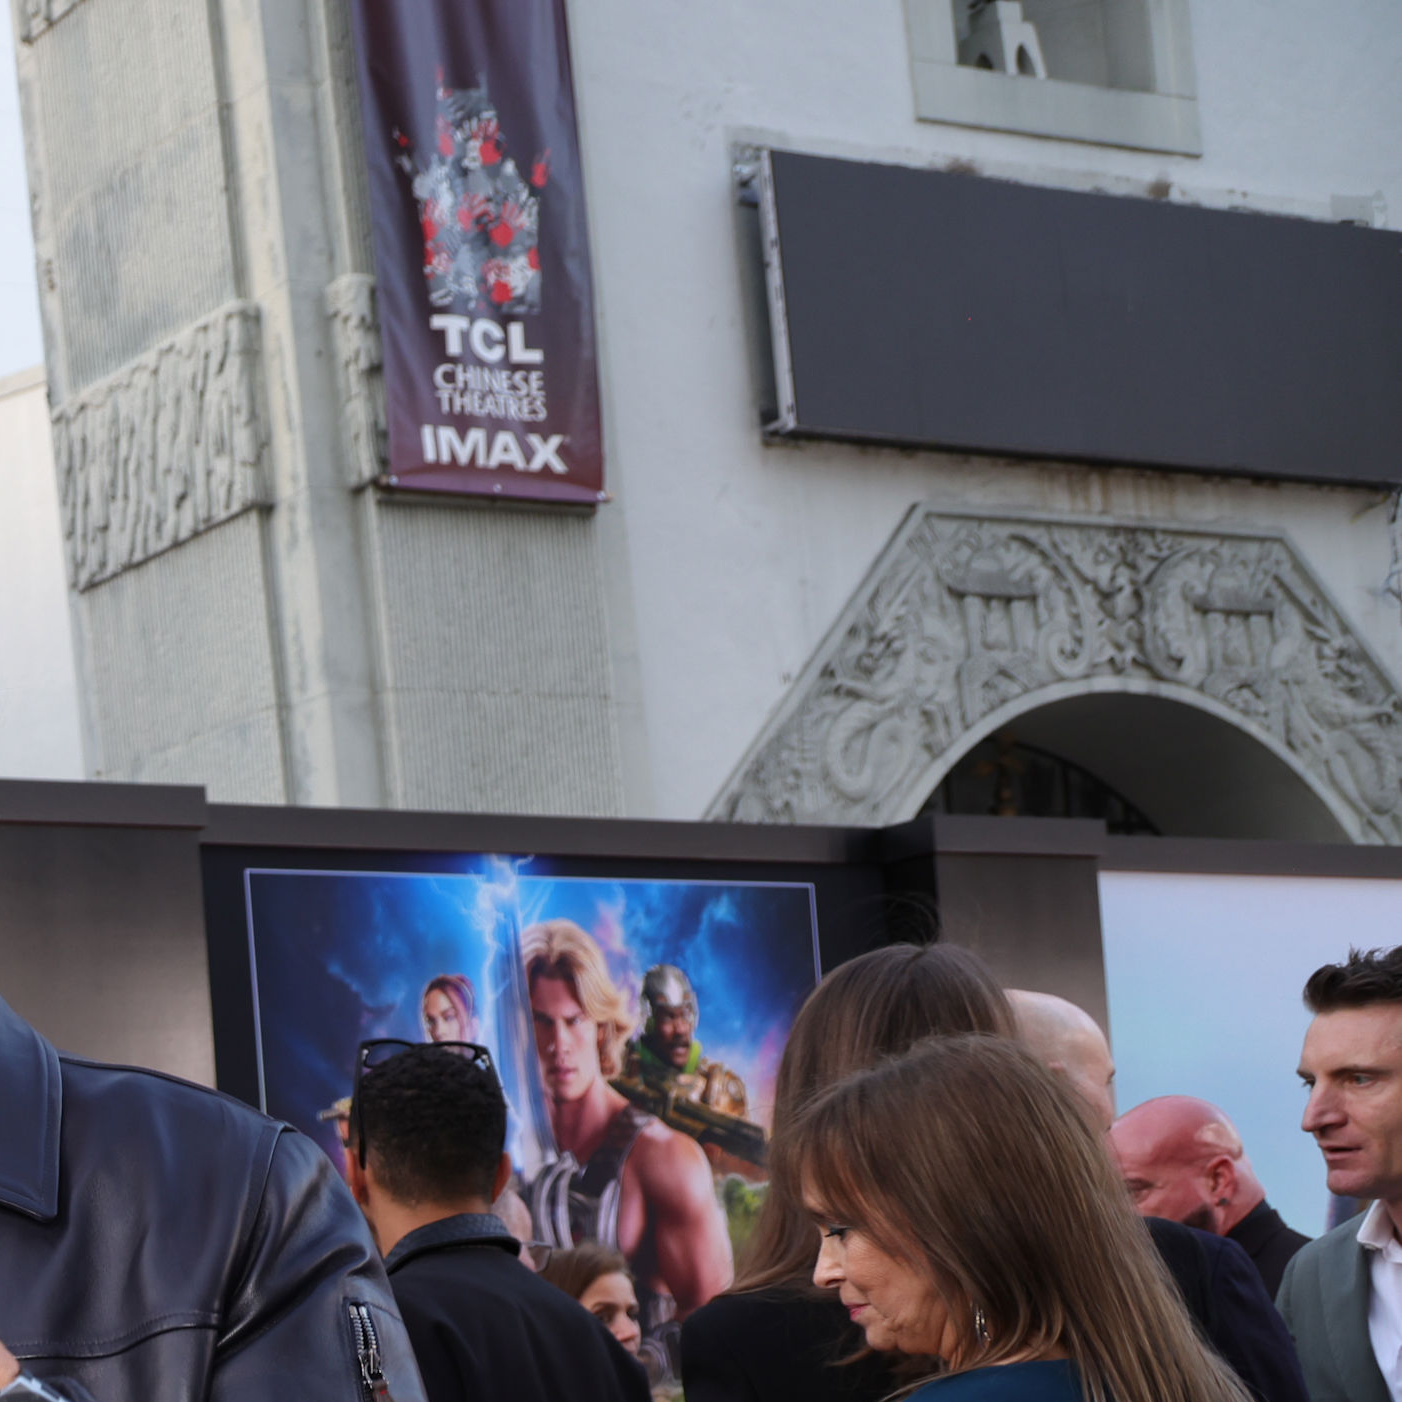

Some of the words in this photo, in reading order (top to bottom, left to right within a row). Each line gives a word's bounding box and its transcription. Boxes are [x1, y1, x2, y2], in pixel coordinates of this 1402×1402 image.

[430, 314, 544, 364] TCL
[434, 362, 545, 398] CHINESE
[437, 391, 547, 422] THEATRES
[420, 424, 570, 474] IMAX
